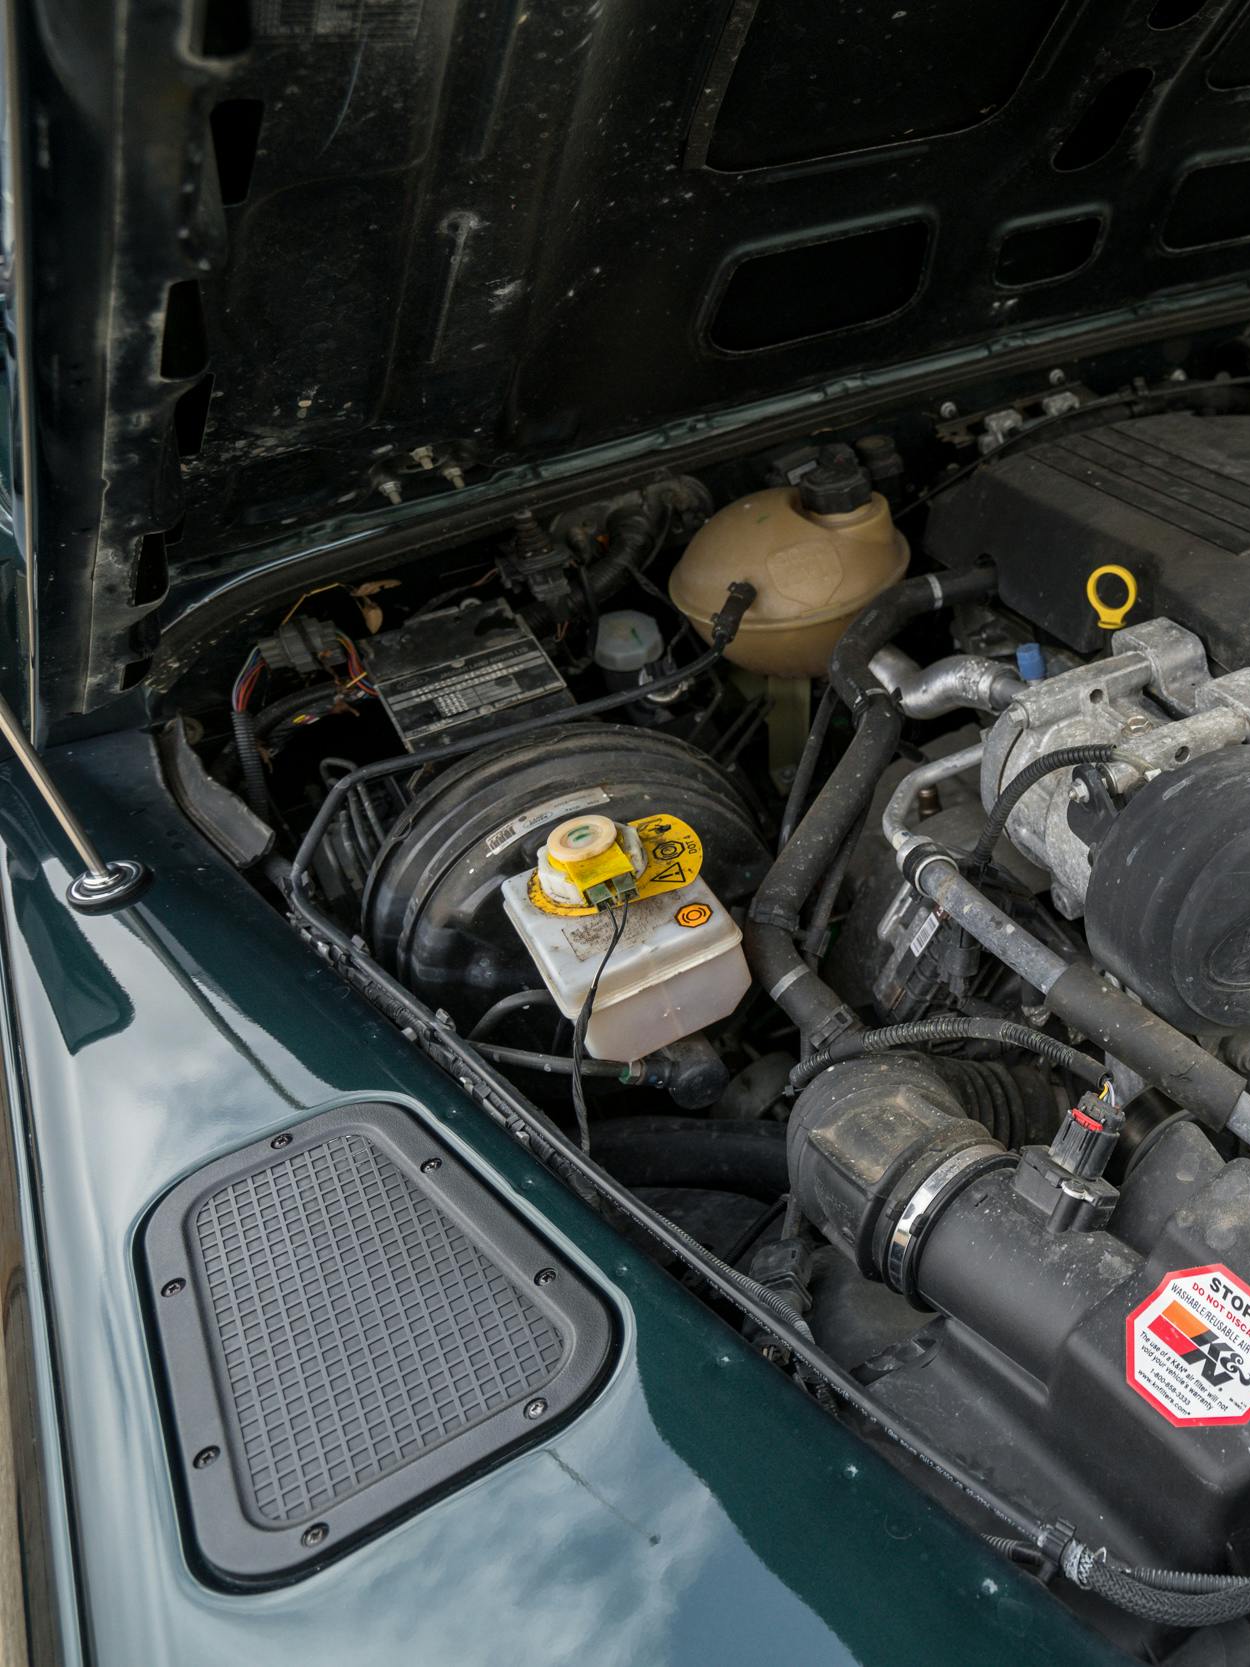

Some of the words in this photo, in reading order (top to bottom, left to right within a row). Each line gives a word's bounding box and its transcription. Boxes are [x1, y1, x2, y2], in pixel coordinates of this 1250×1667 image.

[685, 841, 697, 855] DOT
[1170, 1282, 1239, 1343] WASHABLE/REUSABLE
[1192, 1282, 1205, 1297] DO
[1206, 1294, 1225, 1313] NOT
[1140, 1330, 1151, 1343] The
[1149, 1342, 1161, 1352] use
[1159, 1350, 1169, 1358] of
[1185, 1373, 1195, 1382] air
[1193, 1379, 1208, 1393] filter
[1206, 1391, 1218, 1403] will
[1216, 1400, 1229, 1412] not
[1141, 1344, 1155, 1358] void
[1151, 1355, 1167, 1368] your
[1165, 1367, 1190, 1389] vehicle's
[1188, 1387, 1212, 1411] warranty
[1150, 1368, 1191, 1406] 1-800-858-3333
